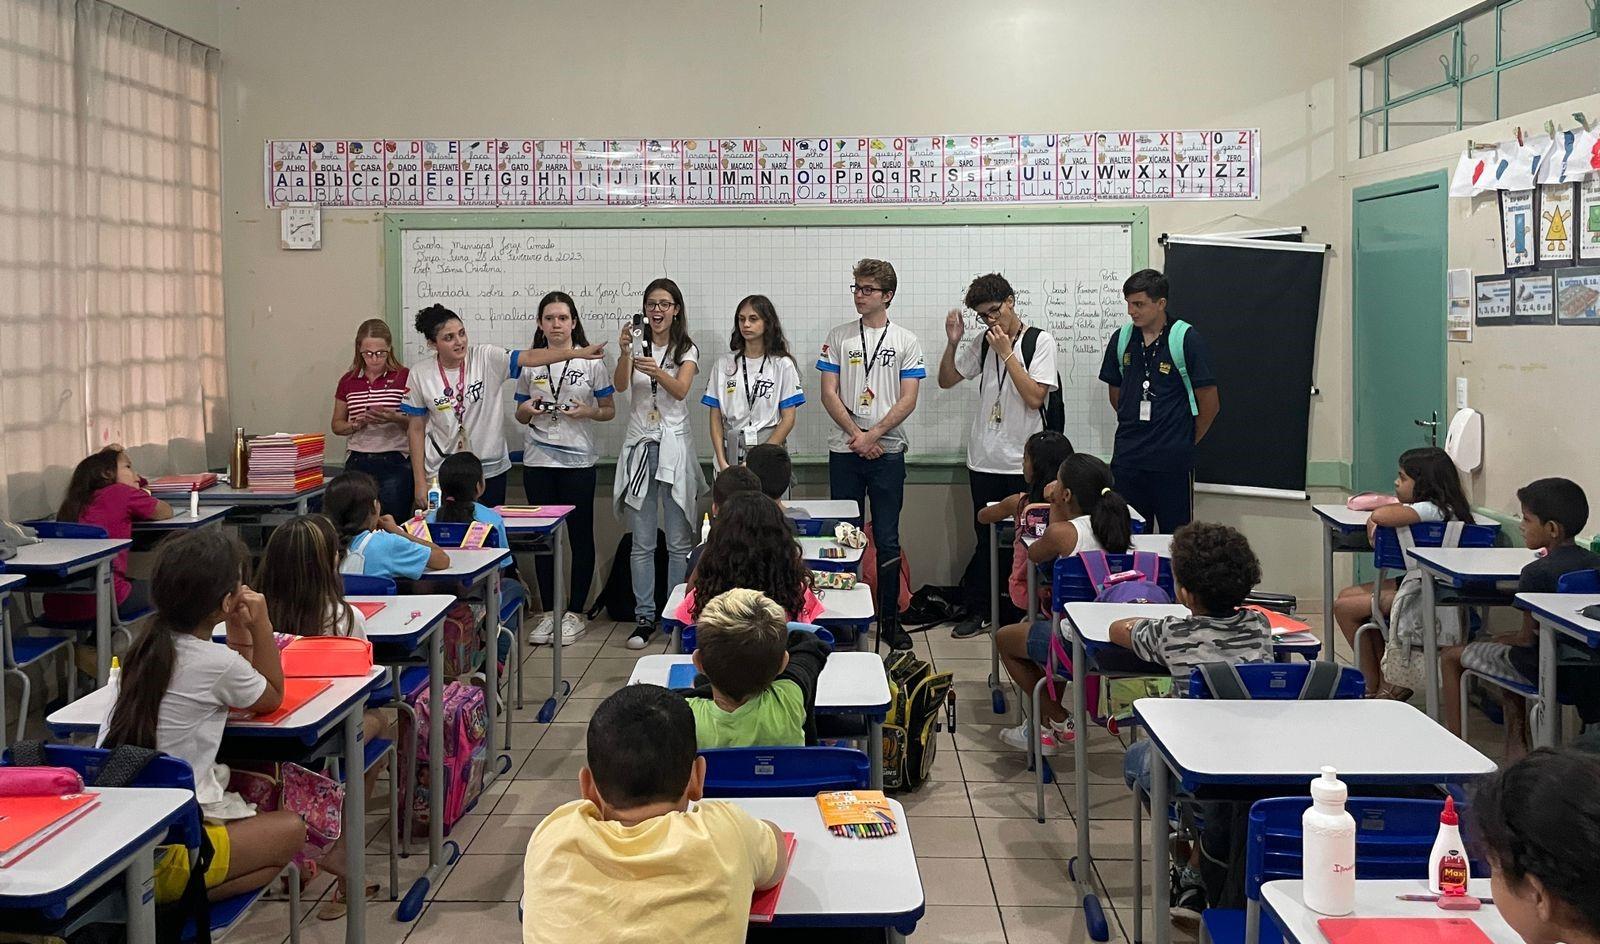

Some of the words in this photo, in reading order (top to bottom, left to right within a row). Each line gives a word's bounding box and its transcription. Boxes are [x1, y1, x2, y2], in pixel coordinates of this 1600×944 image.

[932, 138, 940, 149] R
[971, 138, 978, 149] S
[1008, 137, 1016, 148] T
[1047, 135, 1054, 147] U
[1084, 135, 1092, 146] V
[1119, 134, 1131, 145] W
[1160, 133, 1168, 145] X
[1200, 133, 1208, 144] Y
[1239, 132, 1246, 143] Z
[299, 142, 308, 154] A
[337, 143, 344, 154] B
[374, 142, 382, 154] C
[411, 142, 419, 153] D
[449, 142, 457, 153] E
[487, 142, 494, 153] F
[522, 142, 531, 153] G
[561, 142, 568, 153] H
[672, 141, 680, 152] K
[710, 141, 716, 152] L
[744, 141, 753, 152] M
[783, 140, 791, 151] N
[819, 140, 828, 151] O
[858, 140, 865, 150] P
[894, 139, 903, 151] Q
[872, 170, 884, 183] Q
[892, 172, 899, 183] q
[910, 170, 921, 182] R
[932, 172, 937, 182] r
[948, 169, 958, 182] S
[968, 173, 974, 181] s
[986, 168, 995, 181] T
[1007, 170, 1011, 181] t
[1024, 167, 1034, 180] U
[1044, 171, 1051, 180] u
[1061, 166, 1072, 179] V
[1082, 170, 1089, 179] v
[1098, 165, 1113, 179] W
[1118, 170, 1130, 178] w
[1138, 165, 1149, 178] X
[1159, 169, 1167, 178] x
[1176, 165, 1189, 177] Y
[1198, 168, 1205, 177] y
[1216, 164, 1227, 177] Z
[1237, 168, 1245, 177] z
[277, 175, 287, 186] A
[296, 177, 303, 186] a
[315, 174, 325, 186] B
[334, 175, 342, 186] b
[352, 173, 362, 186] C
[372, 177, 379, 186] c
[390, 173, 400, 185] D
[408, 174, 416, 185] d
[427, 173, 436, 185] E
[446, 176, 453, 185] e
[465, 173, 473, 185] F
[485, 174, 489, 185] f
[501, 173, 511, 185] G
[521, 176, 528, 187] g
[539, 173, 548, 185] H
[558, 174, 566, 185] h
[614, 172, 621, 184] J
[650, 172, 660, 184] K
[670, 173, 677, 185] k
[688, 172, 696, 184] L
[723, 172, 735, 184] M
[742, 175, 752, 184] m
[761, 171, 771, 184] N
[781, 175, 788, 184] n
[798, 171, 809, 183] O
[818, 175, 825, 183] o
[836, 171, 845, 183] P
[855, 172, 862, 184] p
[1444, 868, 1466, 877] Maxi
